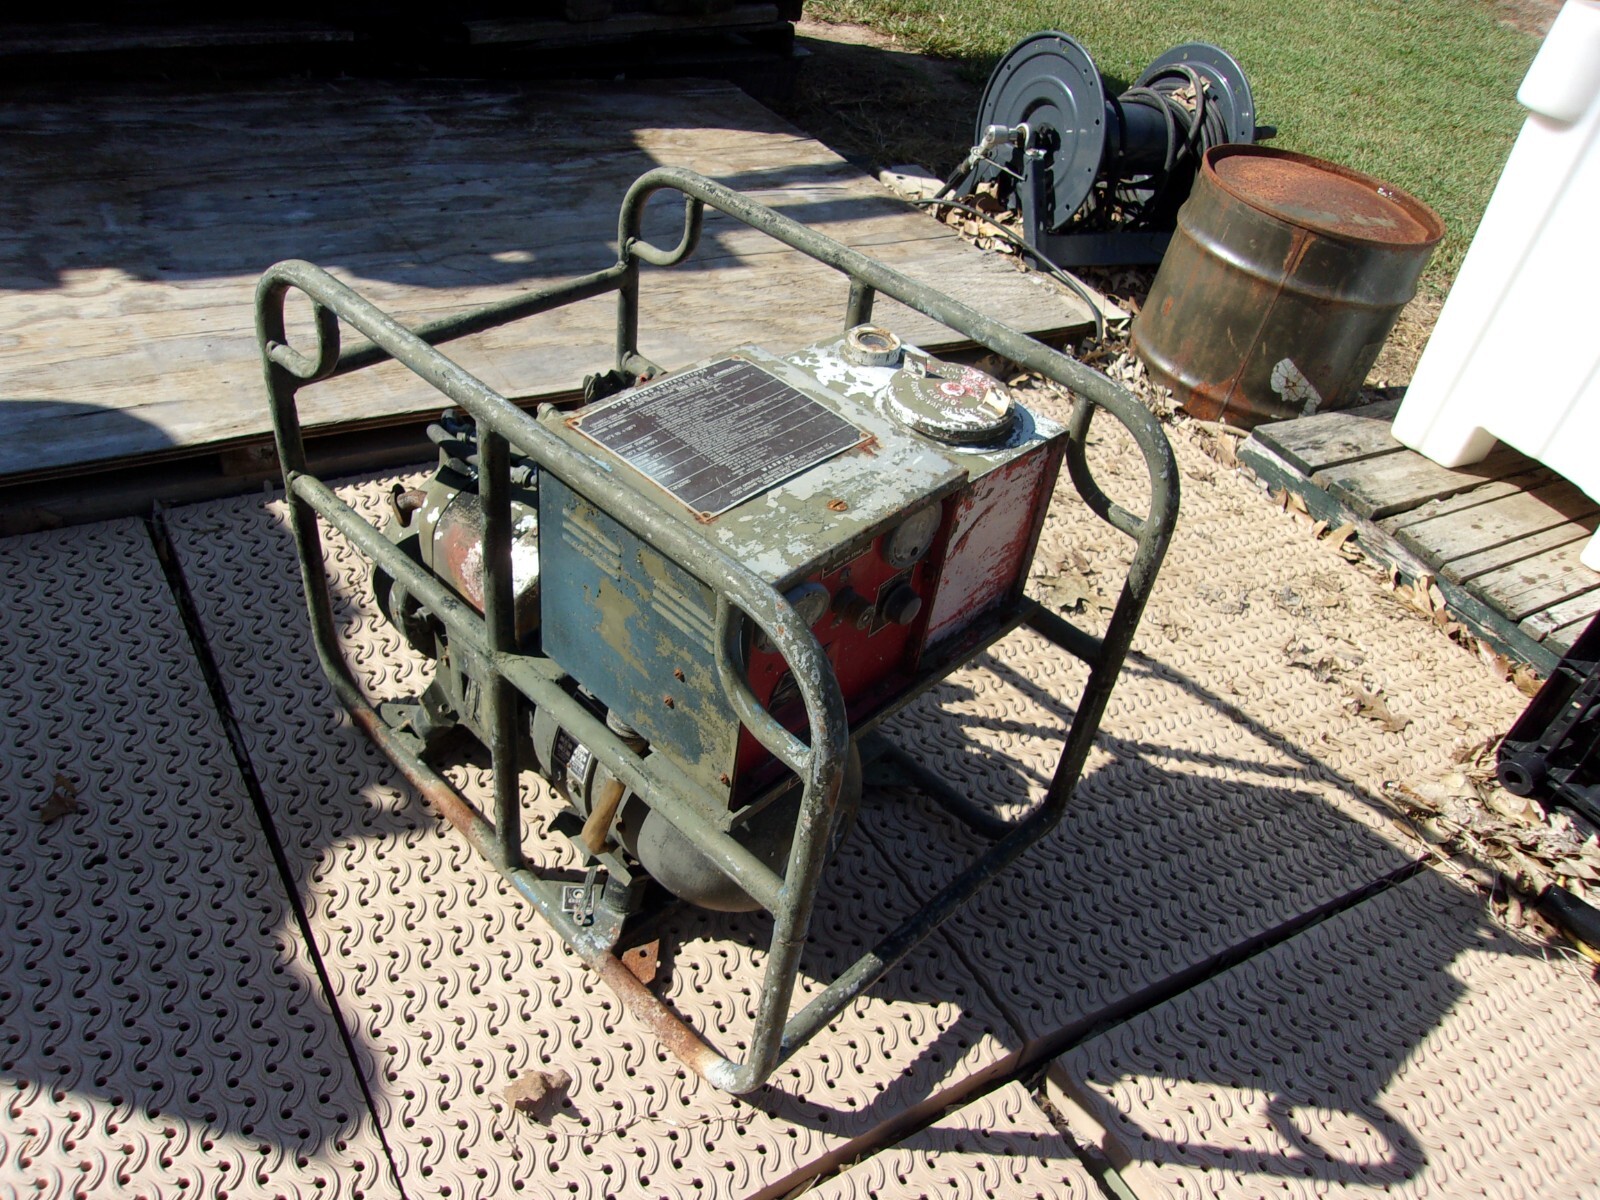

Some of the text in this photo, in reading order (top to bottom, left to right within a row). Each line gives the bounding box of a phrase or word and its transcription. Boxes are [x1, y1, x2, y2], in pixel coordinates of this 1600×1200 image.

[609, 388, 655, 409] OPERATING
[654, 368, 709, 389] INSTRUCTIONS
[759, 454, 796, 472] WARNING
